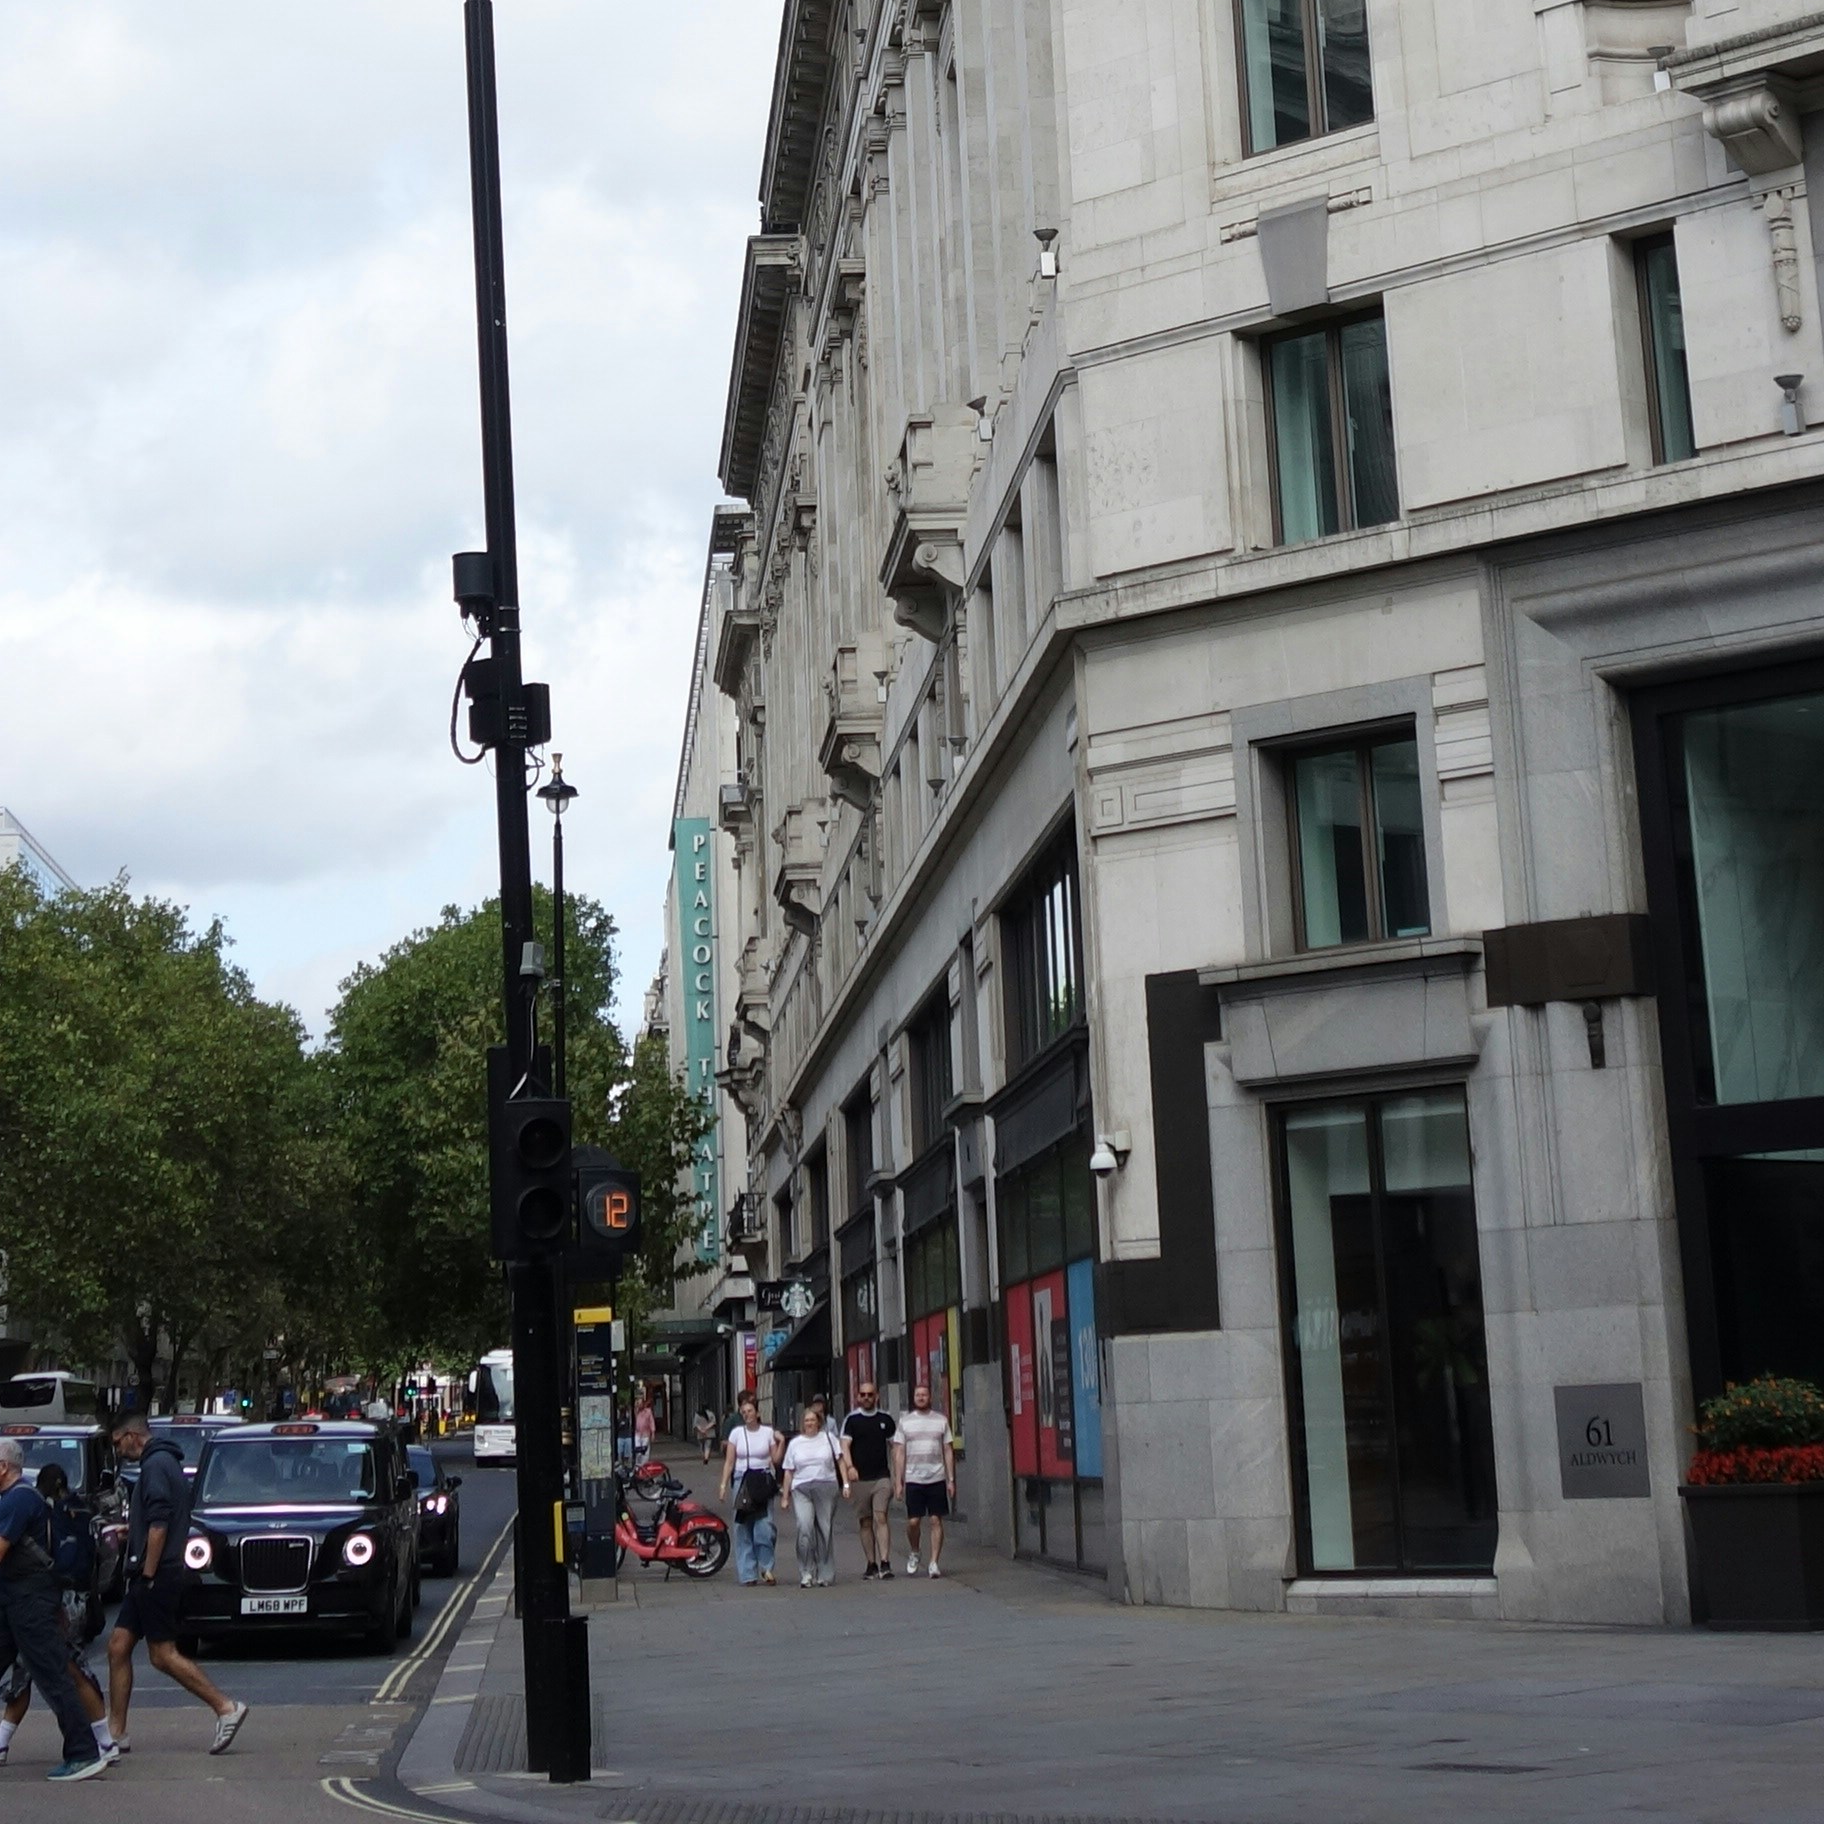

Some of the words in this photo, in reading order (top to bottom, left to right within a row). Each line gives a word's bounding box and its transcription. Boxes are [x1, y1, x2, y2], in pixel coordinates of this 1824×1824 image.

[692, 834, 712, 1020] PEACOCK
[697, 1057, 715, 1250] THATRE
[605, 1192, 629, 1229] 12
[1585, 1414, 1615, 1448] 61
[1570, 1450, 1638, 1466] ALDWYCH
[249, 1600, 281, 1612] LM68
[283, 1599, 305, 1611] WPF
